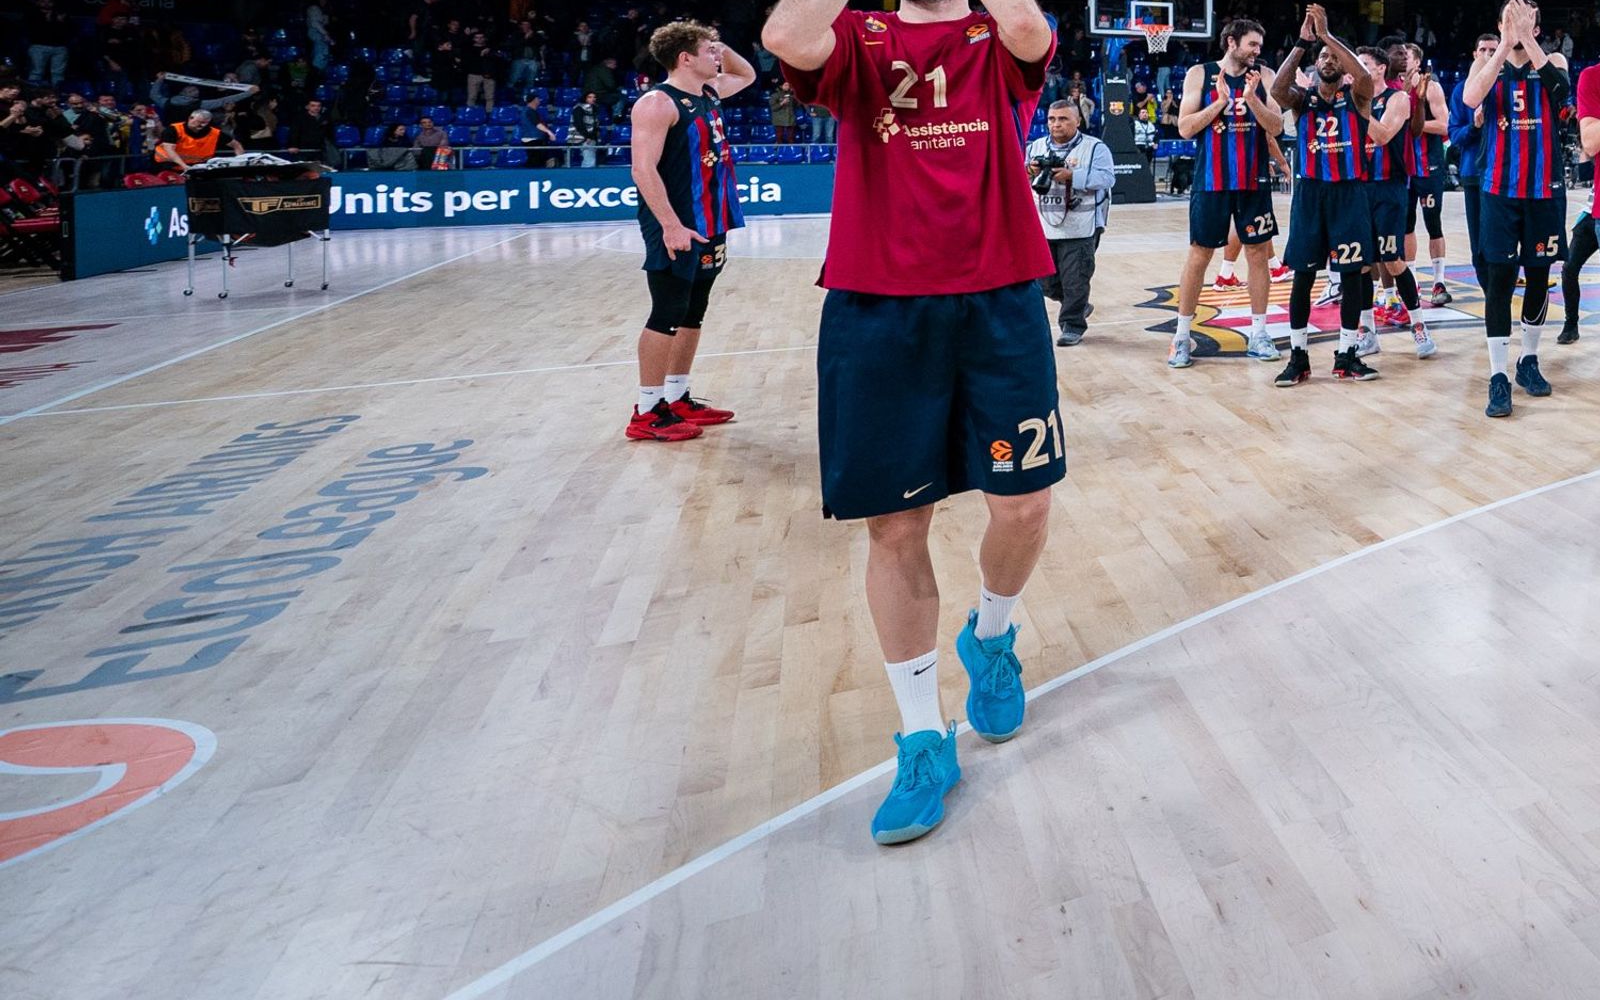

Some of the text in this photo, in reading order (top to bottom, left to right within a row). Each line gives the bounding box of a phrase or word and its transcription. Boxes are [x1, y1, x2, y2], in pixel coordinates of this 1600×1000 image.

[888, 60, 948, 109] 21
[1223, 97, 1247, 116] 23
[1512, 90, 1525, 112] 5
[1316, 116, 1339, 137] 22
[911, 135, 966, 150] anitària
[444, 188, 519, 218] per
[1042, 195, 1063, 205] OTO
[1254, 211, 1274, 235] 23
[715, 244, 727, 267] 3
[1337, 241, 1364, 265] 22
[1378, 235, 1397, 254] 24
[1545, 235, 1560, 257] 5
[1018, 409, 1063, 471] 21
[84, 415, 361, 523] AIRLINES
